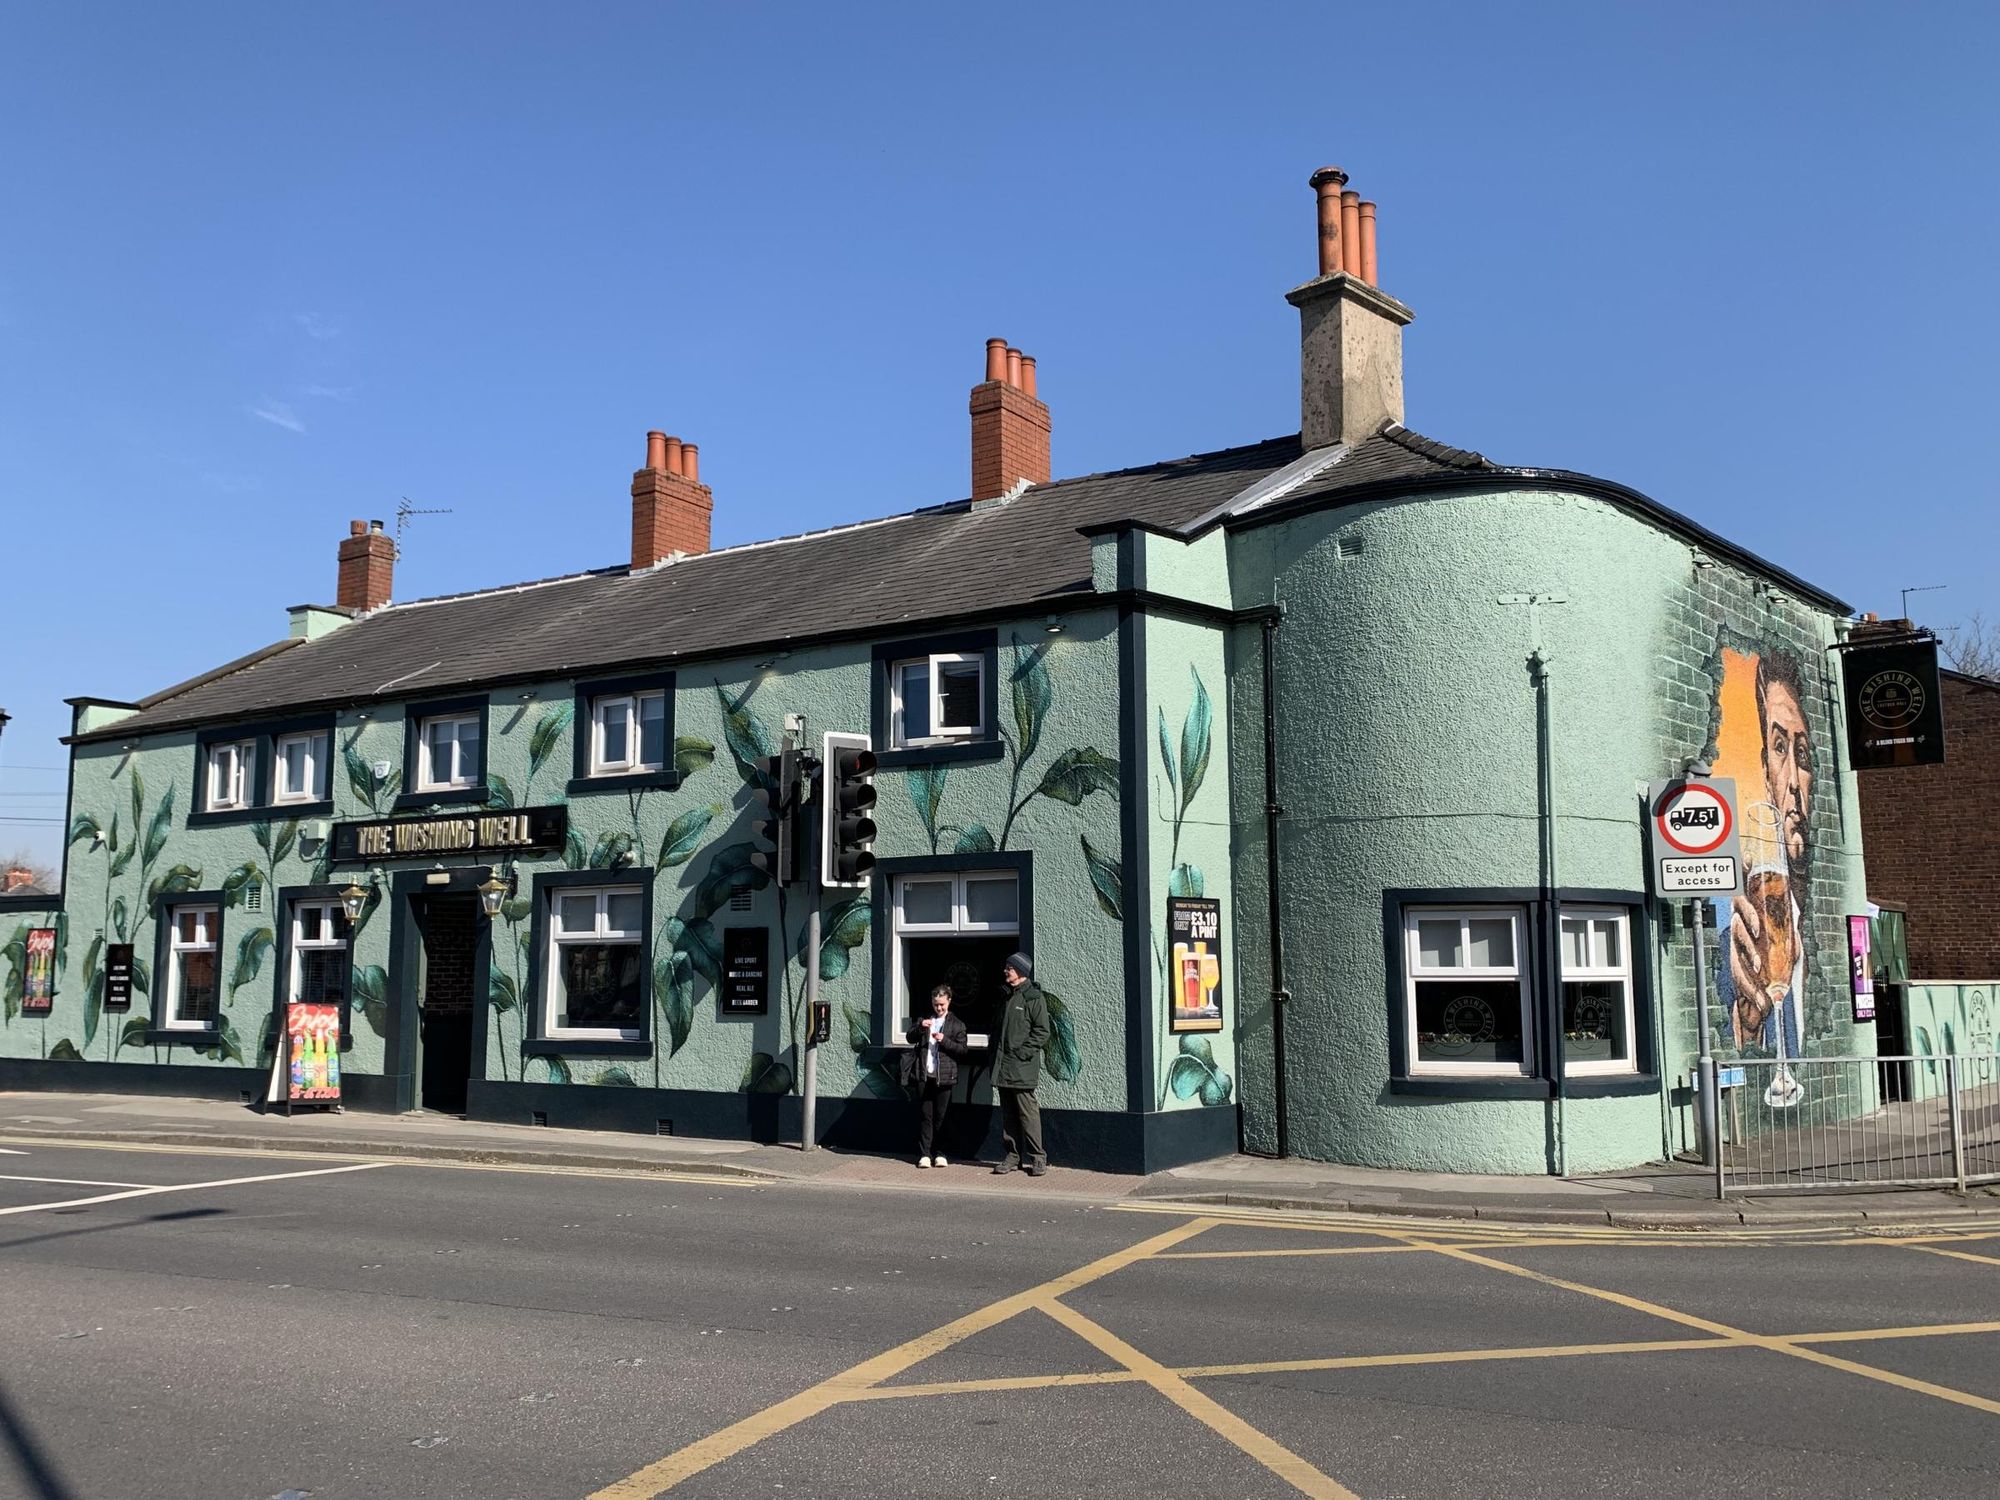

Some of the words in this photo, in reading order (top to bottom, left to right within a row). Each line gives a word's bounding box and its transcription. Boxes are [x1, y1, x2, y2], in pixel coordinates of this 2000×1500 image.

[1864, 672, 1912, 694] WISHING
[1862, 699, 1875, 720] THE
[1909, 686, 1922, 715] WELL
[1685, 808, 1715, 823] 7.5T
[356, 825, 392, 855] THE
[394, 819, 475, 852] WISHING
[478, 814, 533, 847] WELL
[1665, 863, 1708, 875] Except
[1713, 862, 1731, 873] for
[1677, 877, 1721, 886] access
[1174, 911, 1190, 920] FROM
[1191, 911, 1217, 926] £3.10
[1174, 921, 1189, 930] ONLY
[1191, 926, 1198, 938] A
[1199, 926, 1217, 938] PINT
[27, 930, 55, 954] Enjoy
[288, 1003, 339, 1039] Enjoy
